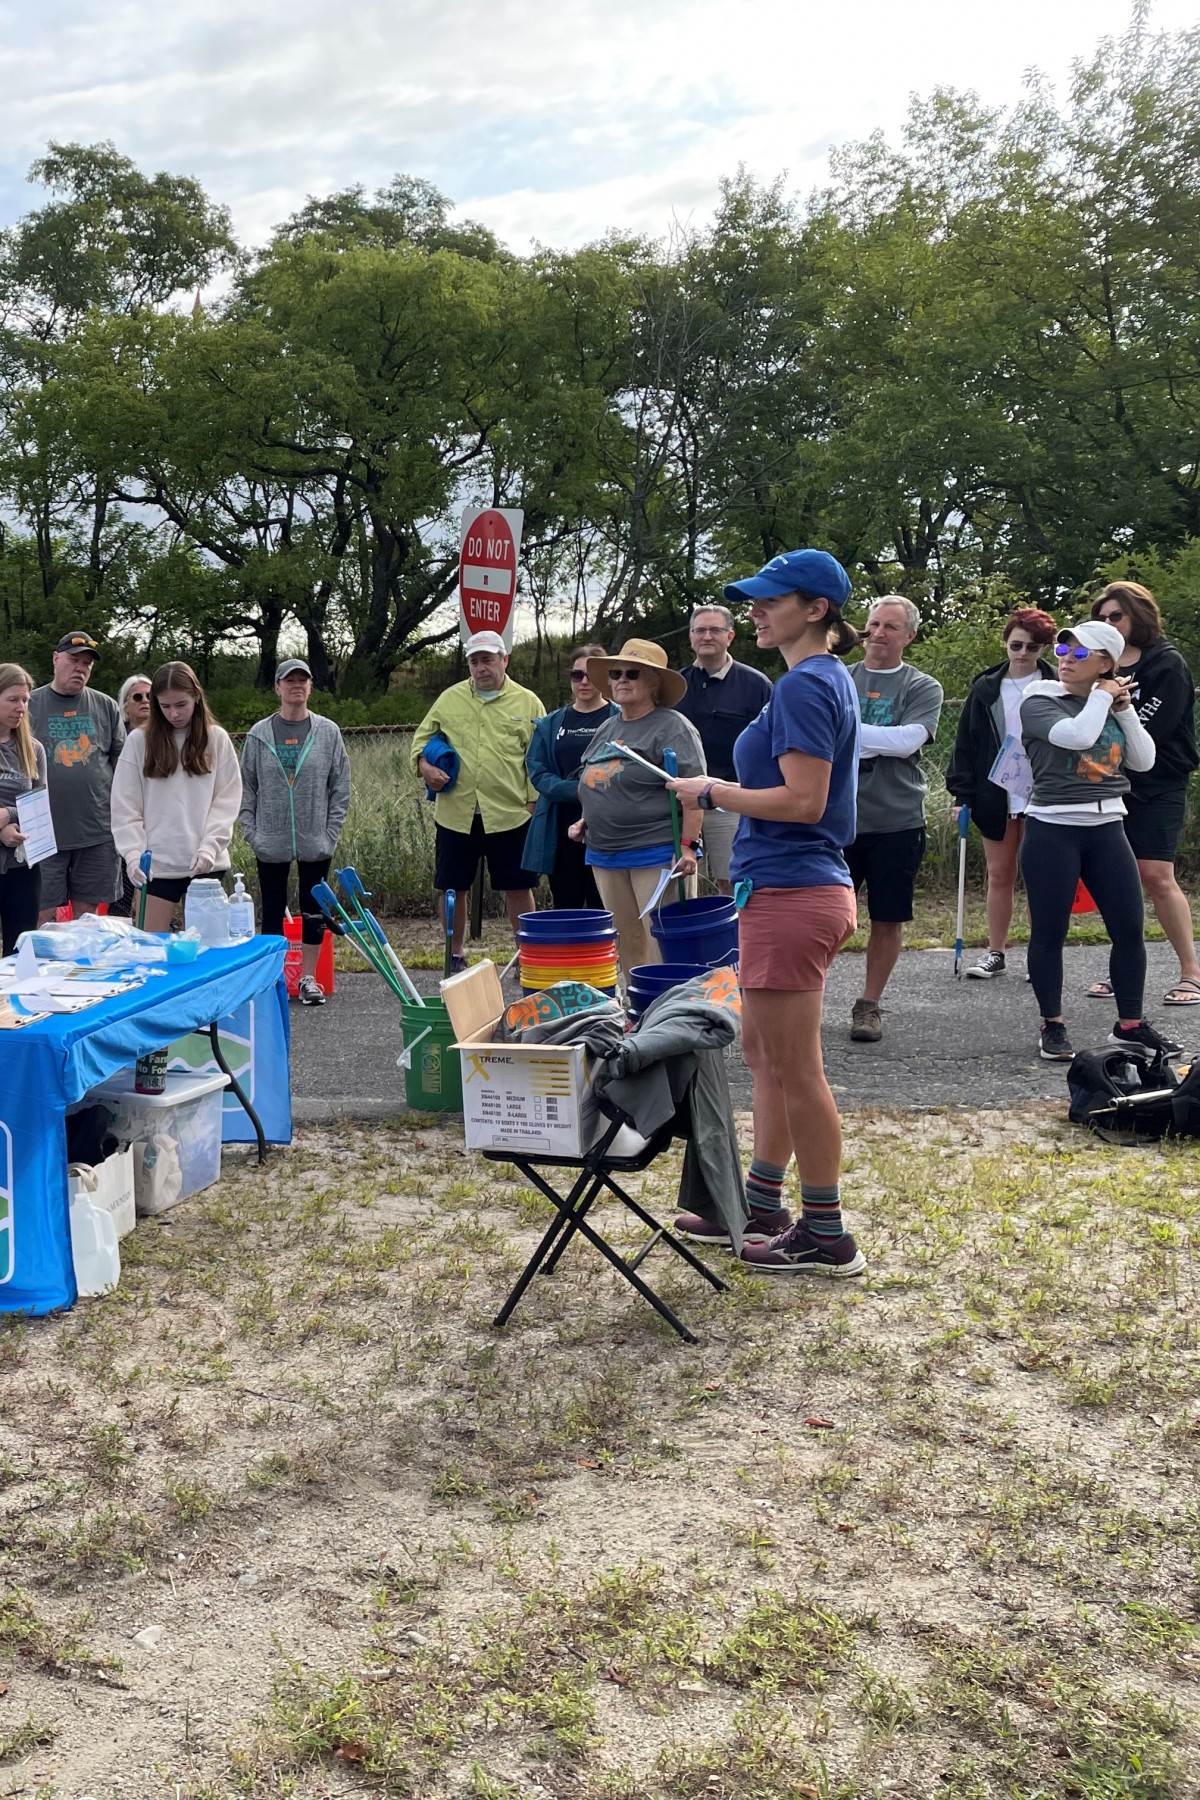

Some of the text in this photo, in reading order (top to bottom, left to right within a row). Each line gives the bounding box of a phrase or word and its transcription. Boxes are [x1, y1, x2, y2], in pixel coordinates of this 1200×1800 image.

[468, 536, 511, 560] DO NOT
[470, 597, 500, 622] ENTER
[151, 1065, 167, 1075] Foo
